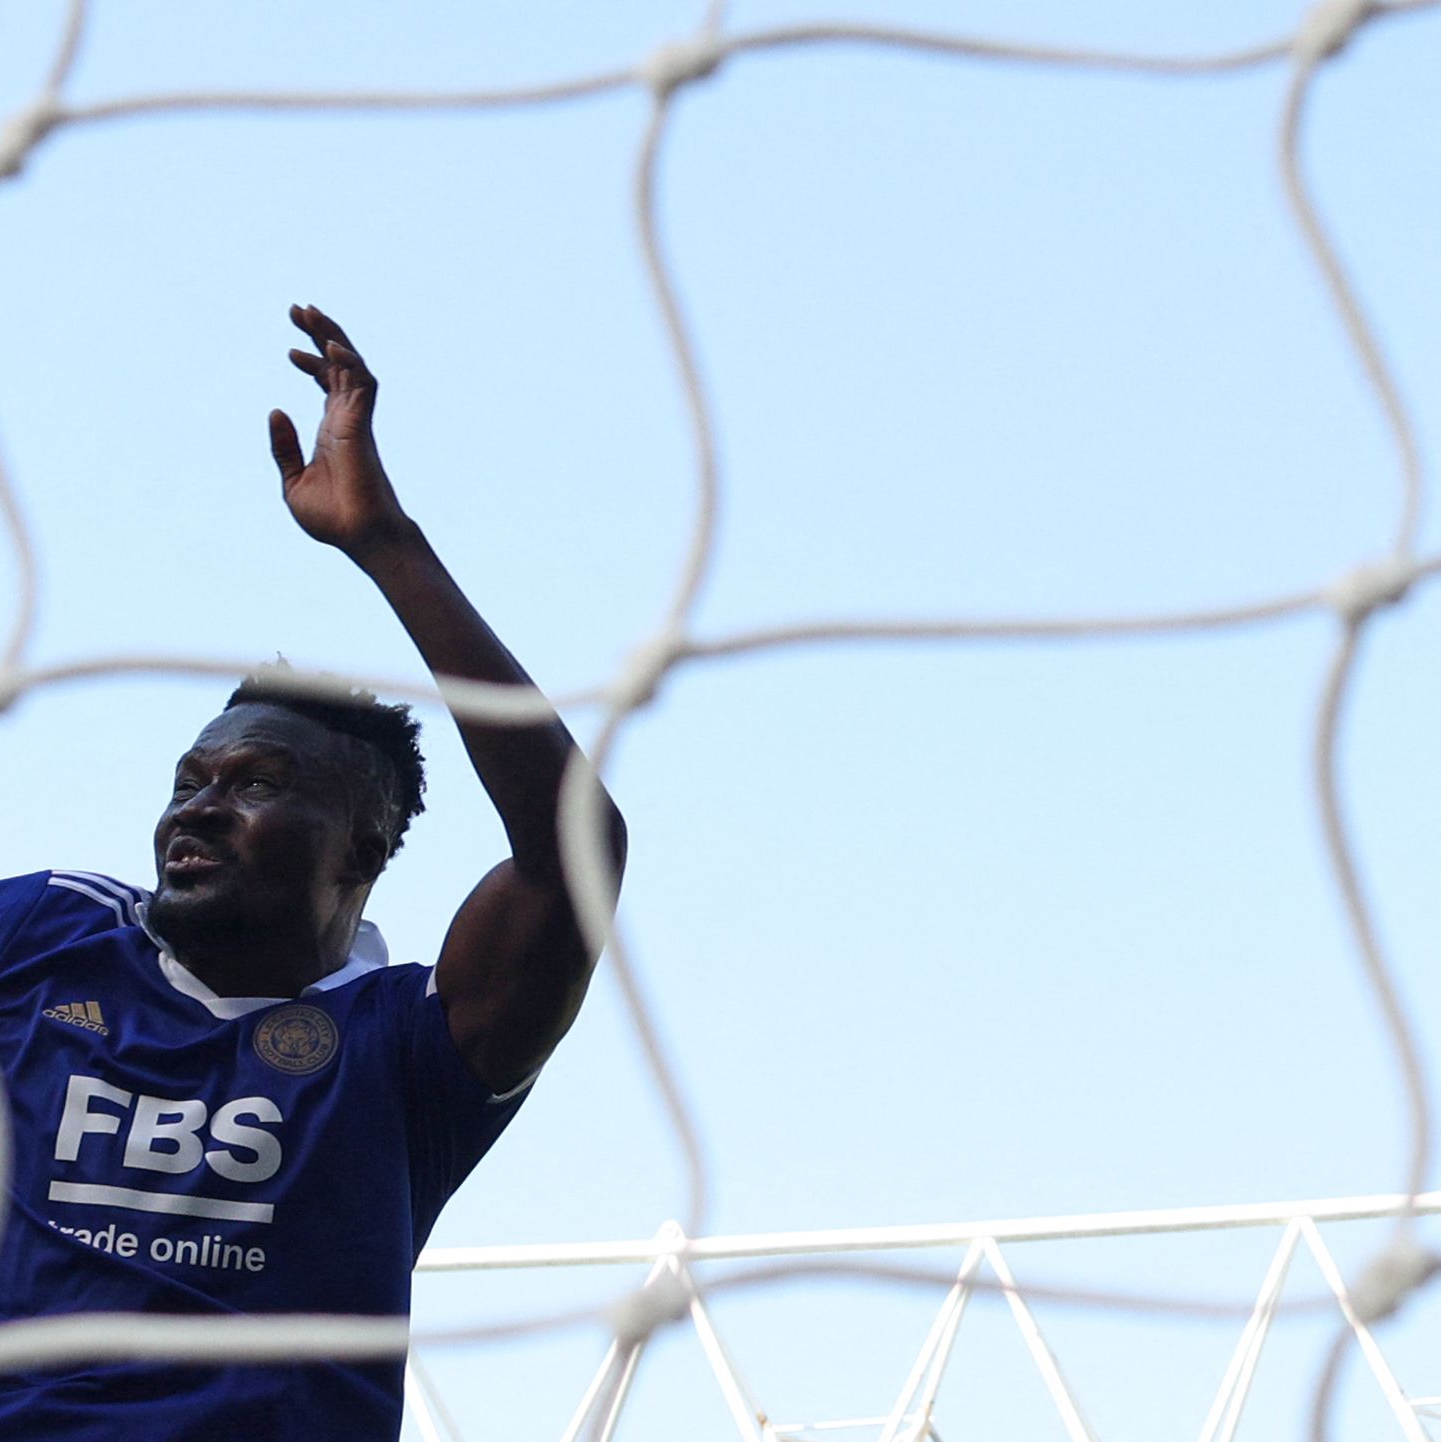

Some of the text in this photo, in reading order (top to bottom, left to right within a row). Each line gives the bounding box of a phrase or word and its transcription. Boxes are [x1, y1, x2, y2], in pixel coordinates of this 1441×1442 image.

[42, 1009, 109, 1036] adidas
[54, 1074, 284, 1183] FBS
[48, 1220, 267, 1272] ade online
